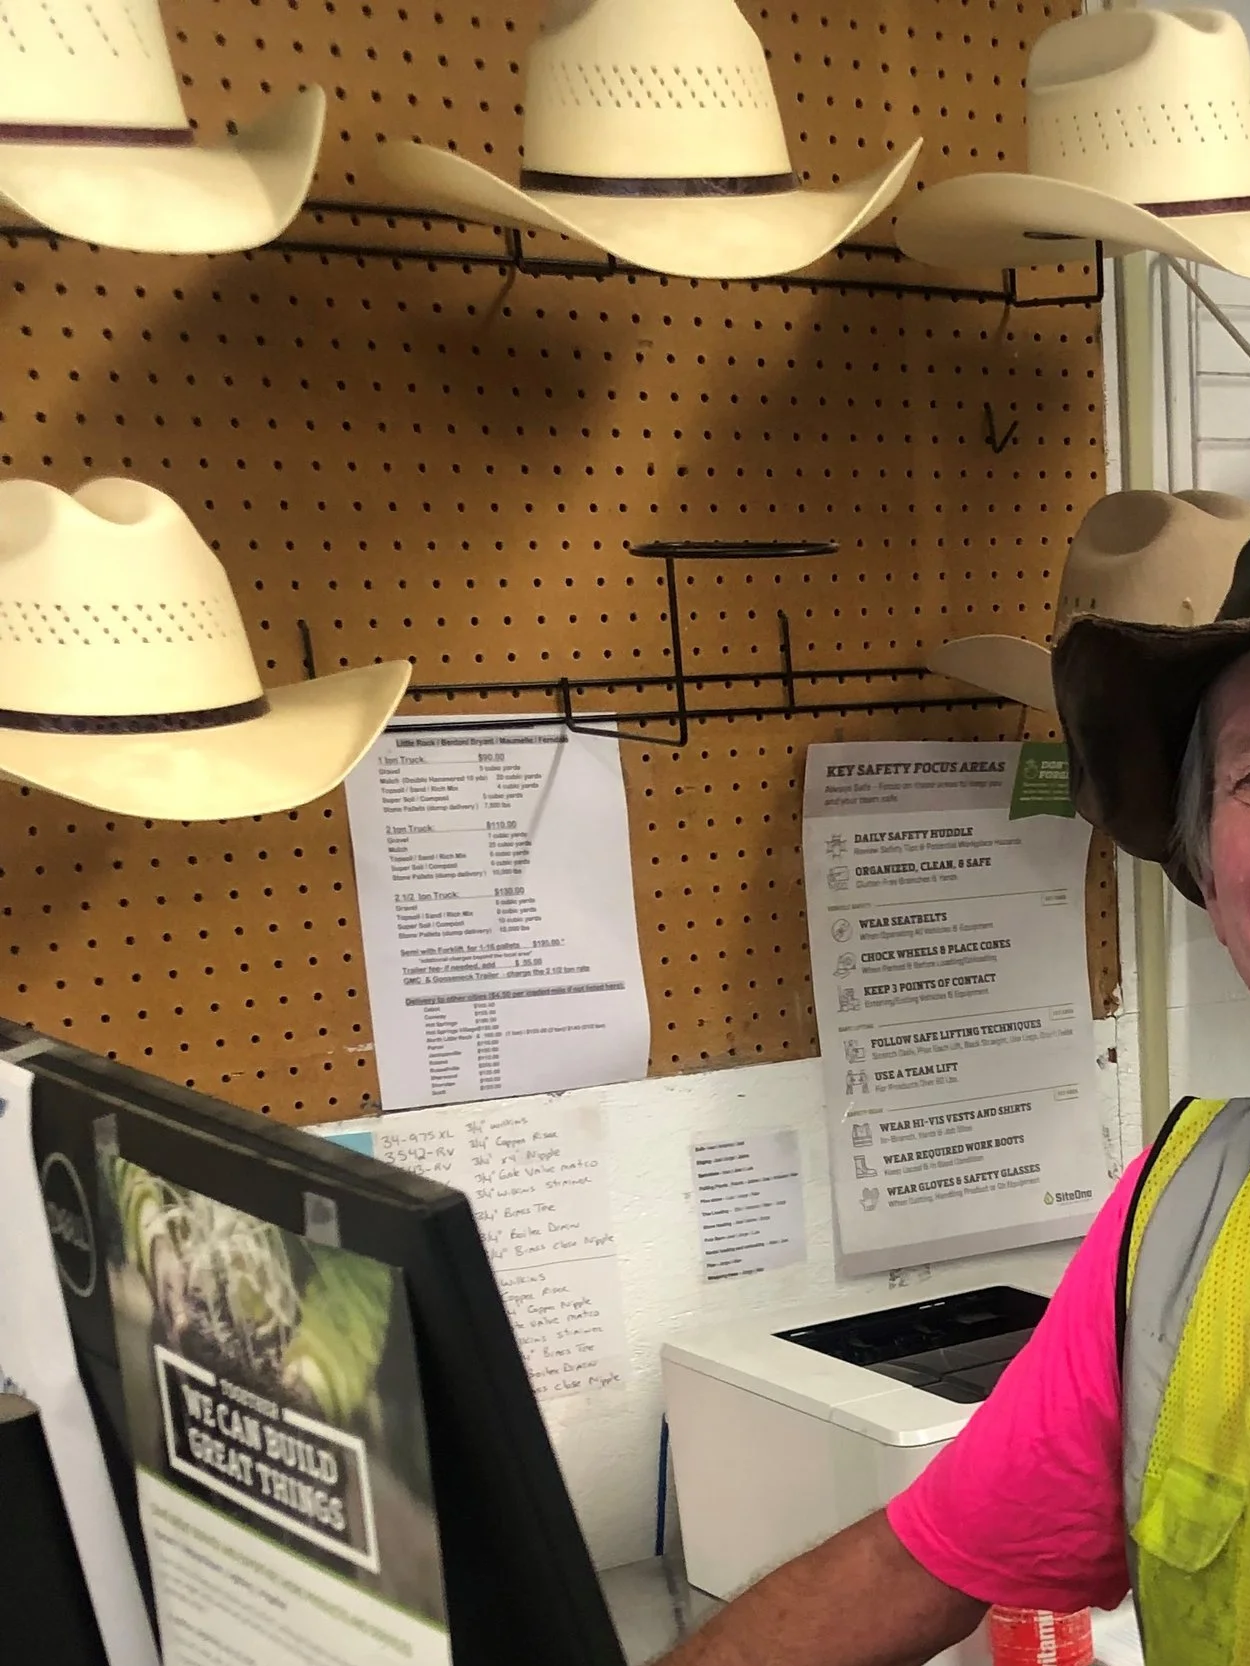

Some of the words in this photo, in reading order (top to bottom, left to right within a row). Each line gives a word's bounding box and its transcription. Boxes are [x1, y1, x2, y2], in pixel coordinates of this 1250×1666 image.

[827, 764, 856, 777] KEY
[857, 763, 911, 775] SAFETY
[913, 761, 957, 774] FOCUS
[959, 761, 1006, 772] AREAS
[854, 833, 887, 843] DAILY
[888, 830, 929, 841] SAFETY
[930, 827, 973, 839] HUDDLE
[855, 864, 918, 876] ORGANIZED,
[920, 860, 956, 872] CLEAN,
[966, 857, 992, 867] SAFE
[859, 917, 890, 929] WEAR
[891, 913, 948, 926] SEATBELTS
[861, 951, 896, 963] CHOCK
[897, 947, 938, 959] WHEELS
[948, 943, 979, 954] PLACE
[980, 939, 1011, 950] CONES
[864, 985, 891, 996] KEEP
[892, 983, 898, 992] 3
[899, 980, 936, 993] POINTS
[938, 978, 950, 988] OF
[952, 974, 996, 986] CONTACT
[871, 1036, 912, 1048] FOLLOW
[913, 1032, 938, 1043] SAFE
[939, 1026, 980, 1040] LIFTING
[981, 1020, 1042, 1035] TECHNIQUES
[874, 1070, 895, 1081] USE
[897, 1069, 904, 1079] A
[905, 1066, 935, 1078] TEAM
[936, 1062, 959, 1073] LIFT
[879, 1120, 911, 1132] WEAR
[912, 1116, 945, 1129] HI-VIS
[946, 1111, 975, 1122] VESTS
[976, 1108, 997, 1119] AND
[998, 1103, 1032, 1115] SHIRTS
[883, 1152, 914, 1165] WEAR
[916, 1144, 964, 1160] REQUIRED
[965, 1140, 993, 1151] WORK
[995, 1135, 1025, 1147] BOOTS
[887, 1185, 918, 1197] WEAR
[919, 1177, 955, 1191] GLOVES
[956, 1176, 962, 1184] &
[964, 1171, 999, 1184] SAFETY
[1001, 1164, 1041, 1178] GLASSES
[1056, 1189, 1092, 1203] SiteOne
[182, 1384, 216, 1428] WE
[217, 1403, 262, 1451] CAN
[263, 1425, 338, 1486] BUILD
[188, 1427, 254, 1486] GREAT
[255, 1461, 346, 1532] THINGS
